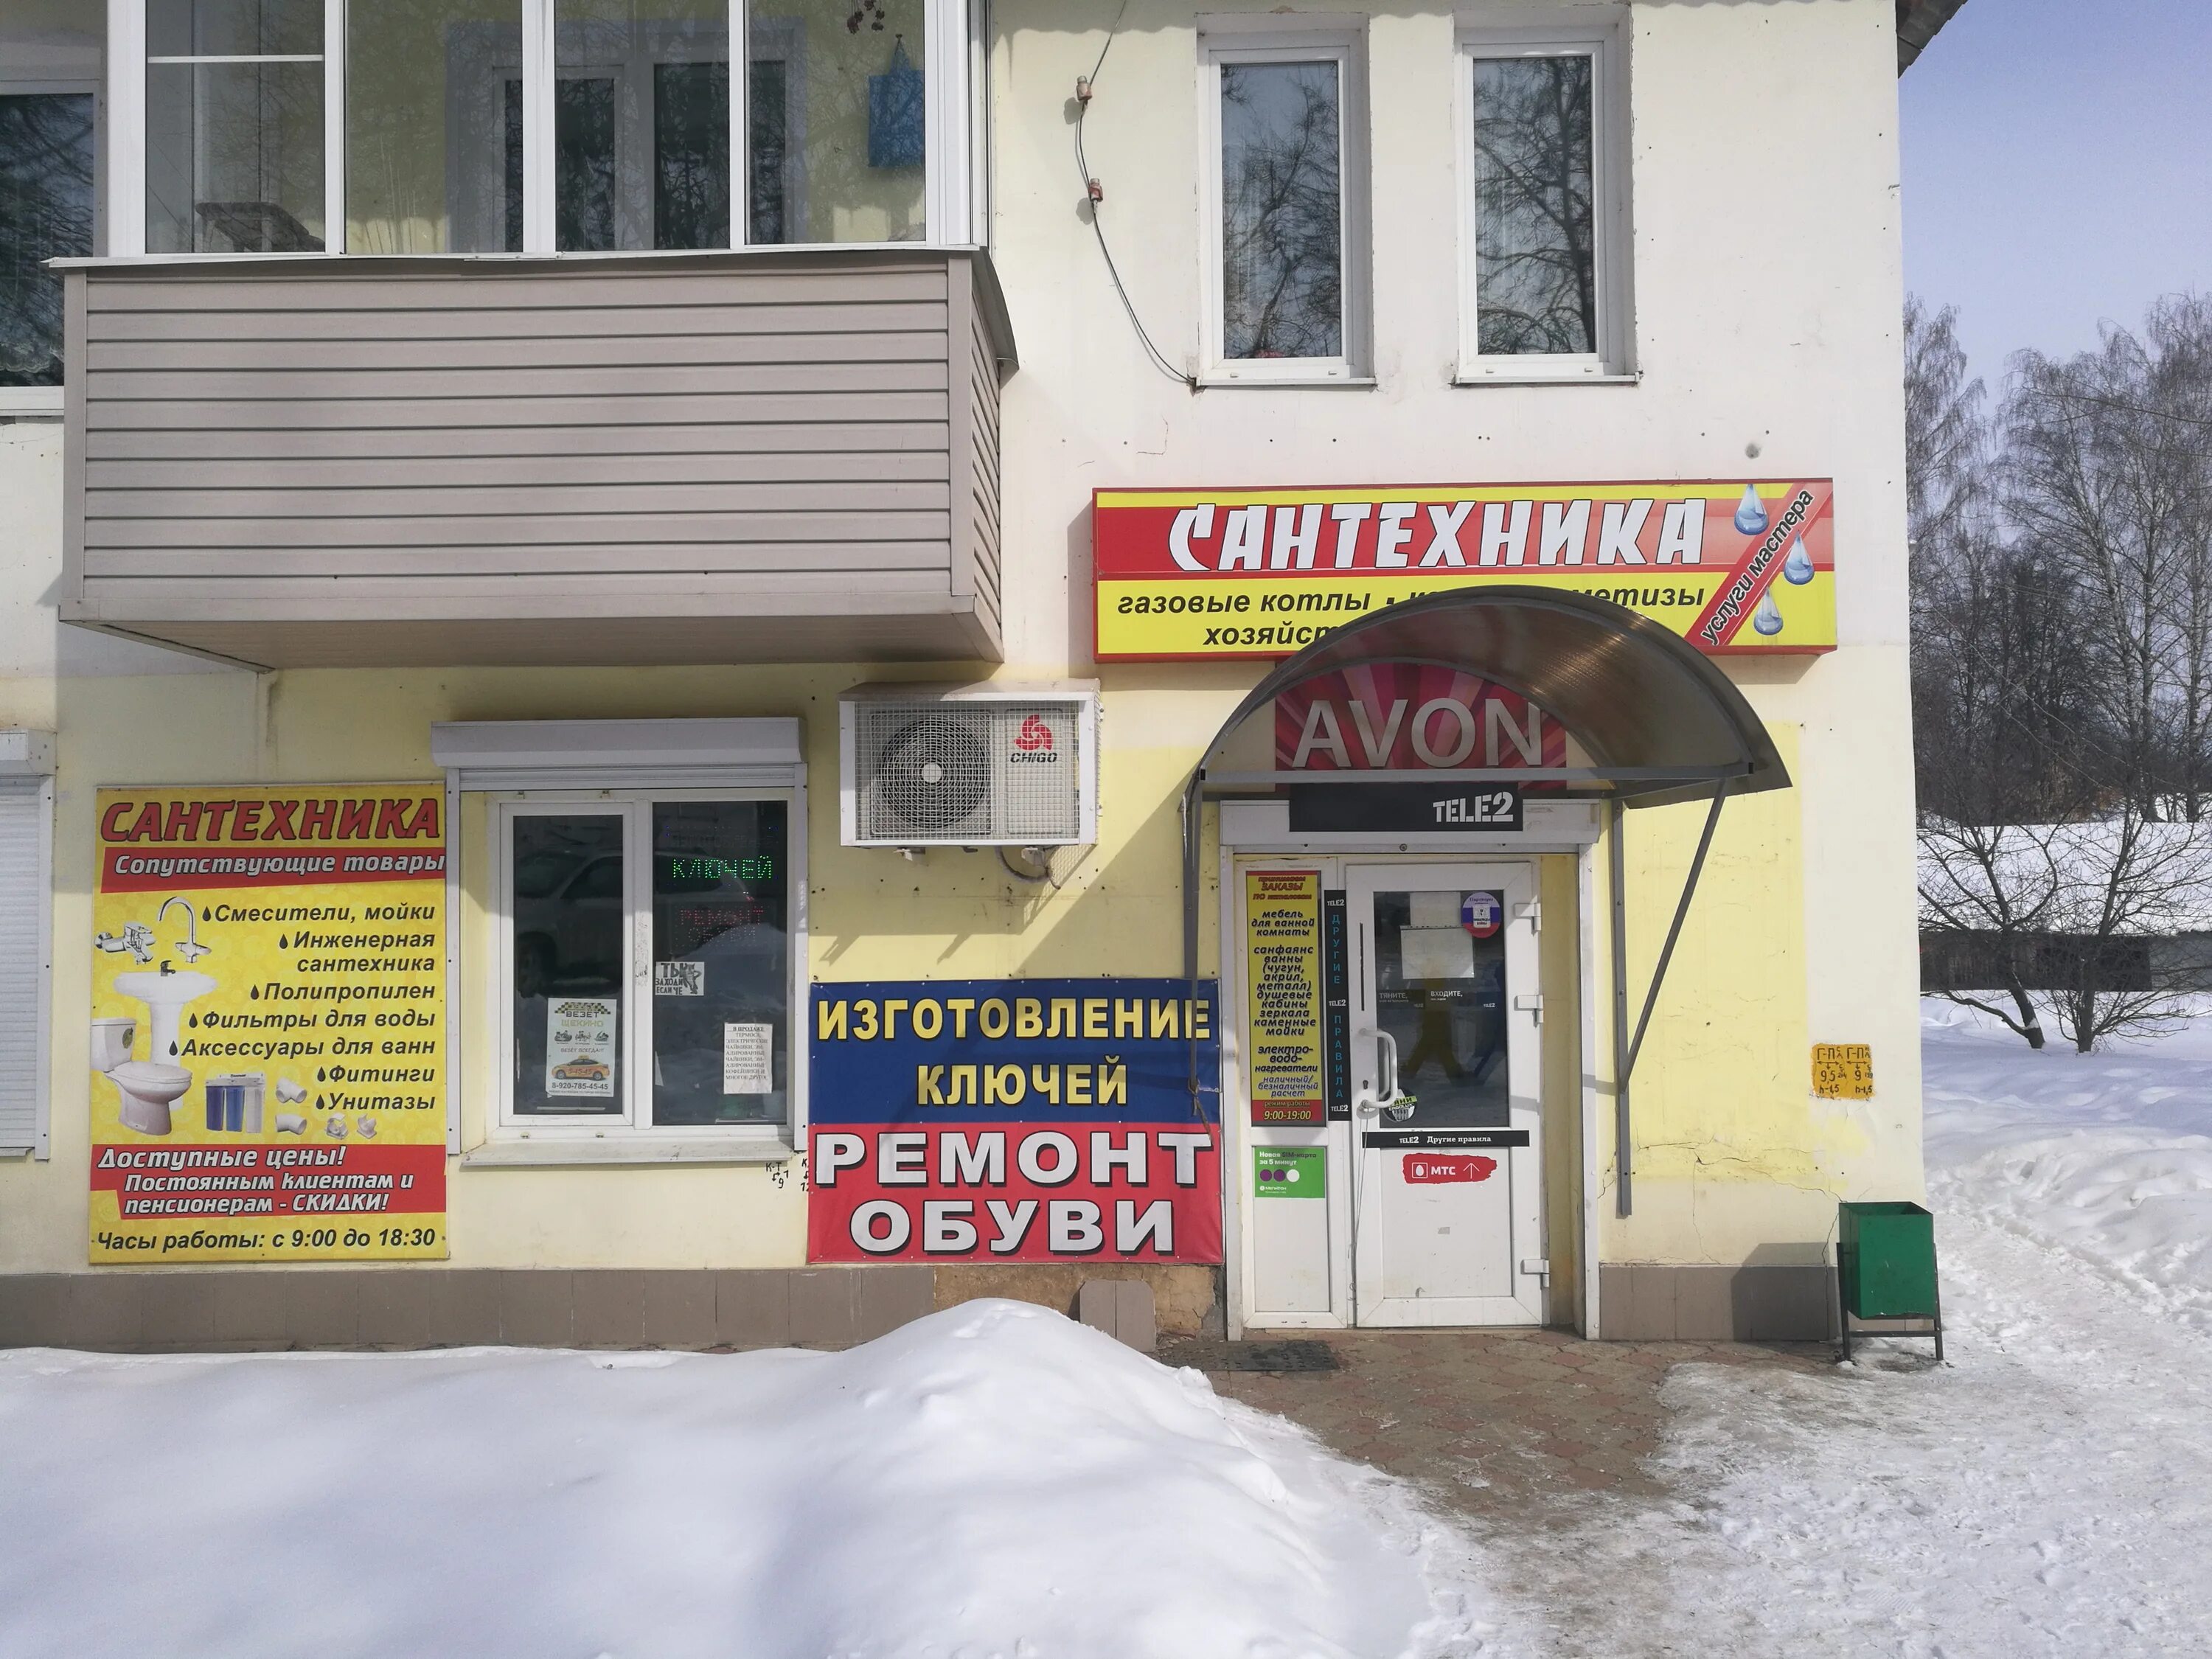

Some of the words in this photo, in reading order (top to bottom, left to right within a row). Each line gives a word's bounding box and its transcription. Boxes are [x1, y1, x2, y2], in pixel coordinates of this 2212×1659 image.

[1168, 498, 1706, 571] САНТЕХНИКА
[1701, 573, 1755, 645] услуги
[1747, 489, 1814, 581] мастера
[1117, 592, 1251, 614] газовые
[1260, 591, 1371, 612] котлы
[1292, 698, 1542, 768] AVON
[1010, 752, 1057, 764] CHIGO
[1433, 791, 1513, 823] TELE2
[101, 799, 439, 842] САНТЕХНИКА
[114, 854, 335, 877] Сопутствующие
[344, 854, 445, 875] товары
[672, 855, 773, 879] КЛЮЧЕЙ
[215, 903, 356, 923] Смесители,
[364, 901, 435, 920] мойки
[1262, 909, 1304, 919] мебель
[1251, 918, 1270, 927] для
[1274, 918, 1315, 927] ванной
[294, 931, 435, 951] Инженерная
[1253, 945, 1313, 955] санфаянс
[297, 957, 435, 973] сантехника
[1262, 962, 1304, 974] (чугун,
[1256, 981, 1312, 991] металл)
[1264, 973, 1304, 983] акрил,
[264, 983, 435, 1004] Полипропилен
[1256, 990, 1312, 1001] душевые
[1262, 999, 1307, 1009] кабины
[202, 1011, 327, 1032] Фильтры
[333, 1010, 369, 1028] для
[375, 1009, 435, 1027] воды
[818, 997, 1211, 1042] ИЗГОТОВЛЕНИЕ
[1259, 1009, 1310, 1018] зеркала
[1253, 1019, 1316, 1027] каменные
[1266, 1027, 1304, 1036] мойки
[181, 1039, 324, 1058] Аксессуары
[332, 1037, 372, 1055] для
[381, 1040, 435, 1054] ванн
[1258, 1046, 1313, 1057] электро-
[1270, 1054, 1302, 1063] водо-
[329, 1065, 435, 1083] Фитинги
[1255, 1065, 1318, 1074] нагреватели
[1854, 1070, 1861, 1081] 9
[552, 1082, 608, 1091] 8-920-785-45-45
[917, 1054, 1128, 1107] КЛЮЧЕЙ
[1258, 1082, 1318, 1090] безналичный
[1263, 1075, 1314, 1083] наличный/
[328, 1093, 435, 1110] Унитазы
[1264, 1110, 1312, 1120] 9:00-19:00
[1427, 1135, 1456, 1144] Другие
[1458, 1135, 1492, 1144] правила
[97, 1149, 257, 1172] Доступные
[265, 1146, 346, 1169] цены!
[815, 1130, 1213, 1187] РЕМОНТ
[1430, 1166, 1456, 1175] МТС
[125, 1174, 274, 1192] Постоянным
[400, 1175, 413, 1189] и
[779, 1178, 784, 1189] 9
[125, 1197, 273, 1217] пенсионерам
[292, 1193, 389, 1212] СКИДКИ!
[850, 1199, 1175, 1255] ОБУВИ
[97, 1232, 157, 1251] Часы
[163, 1229, 265, 1253] работы:
[272, 1234, 285, 1248] с
[292, 1229, 336, 1247] 9:00
[343, 1226, 370, 1246] до
[378, 1228, 435, 1247] 18:30
